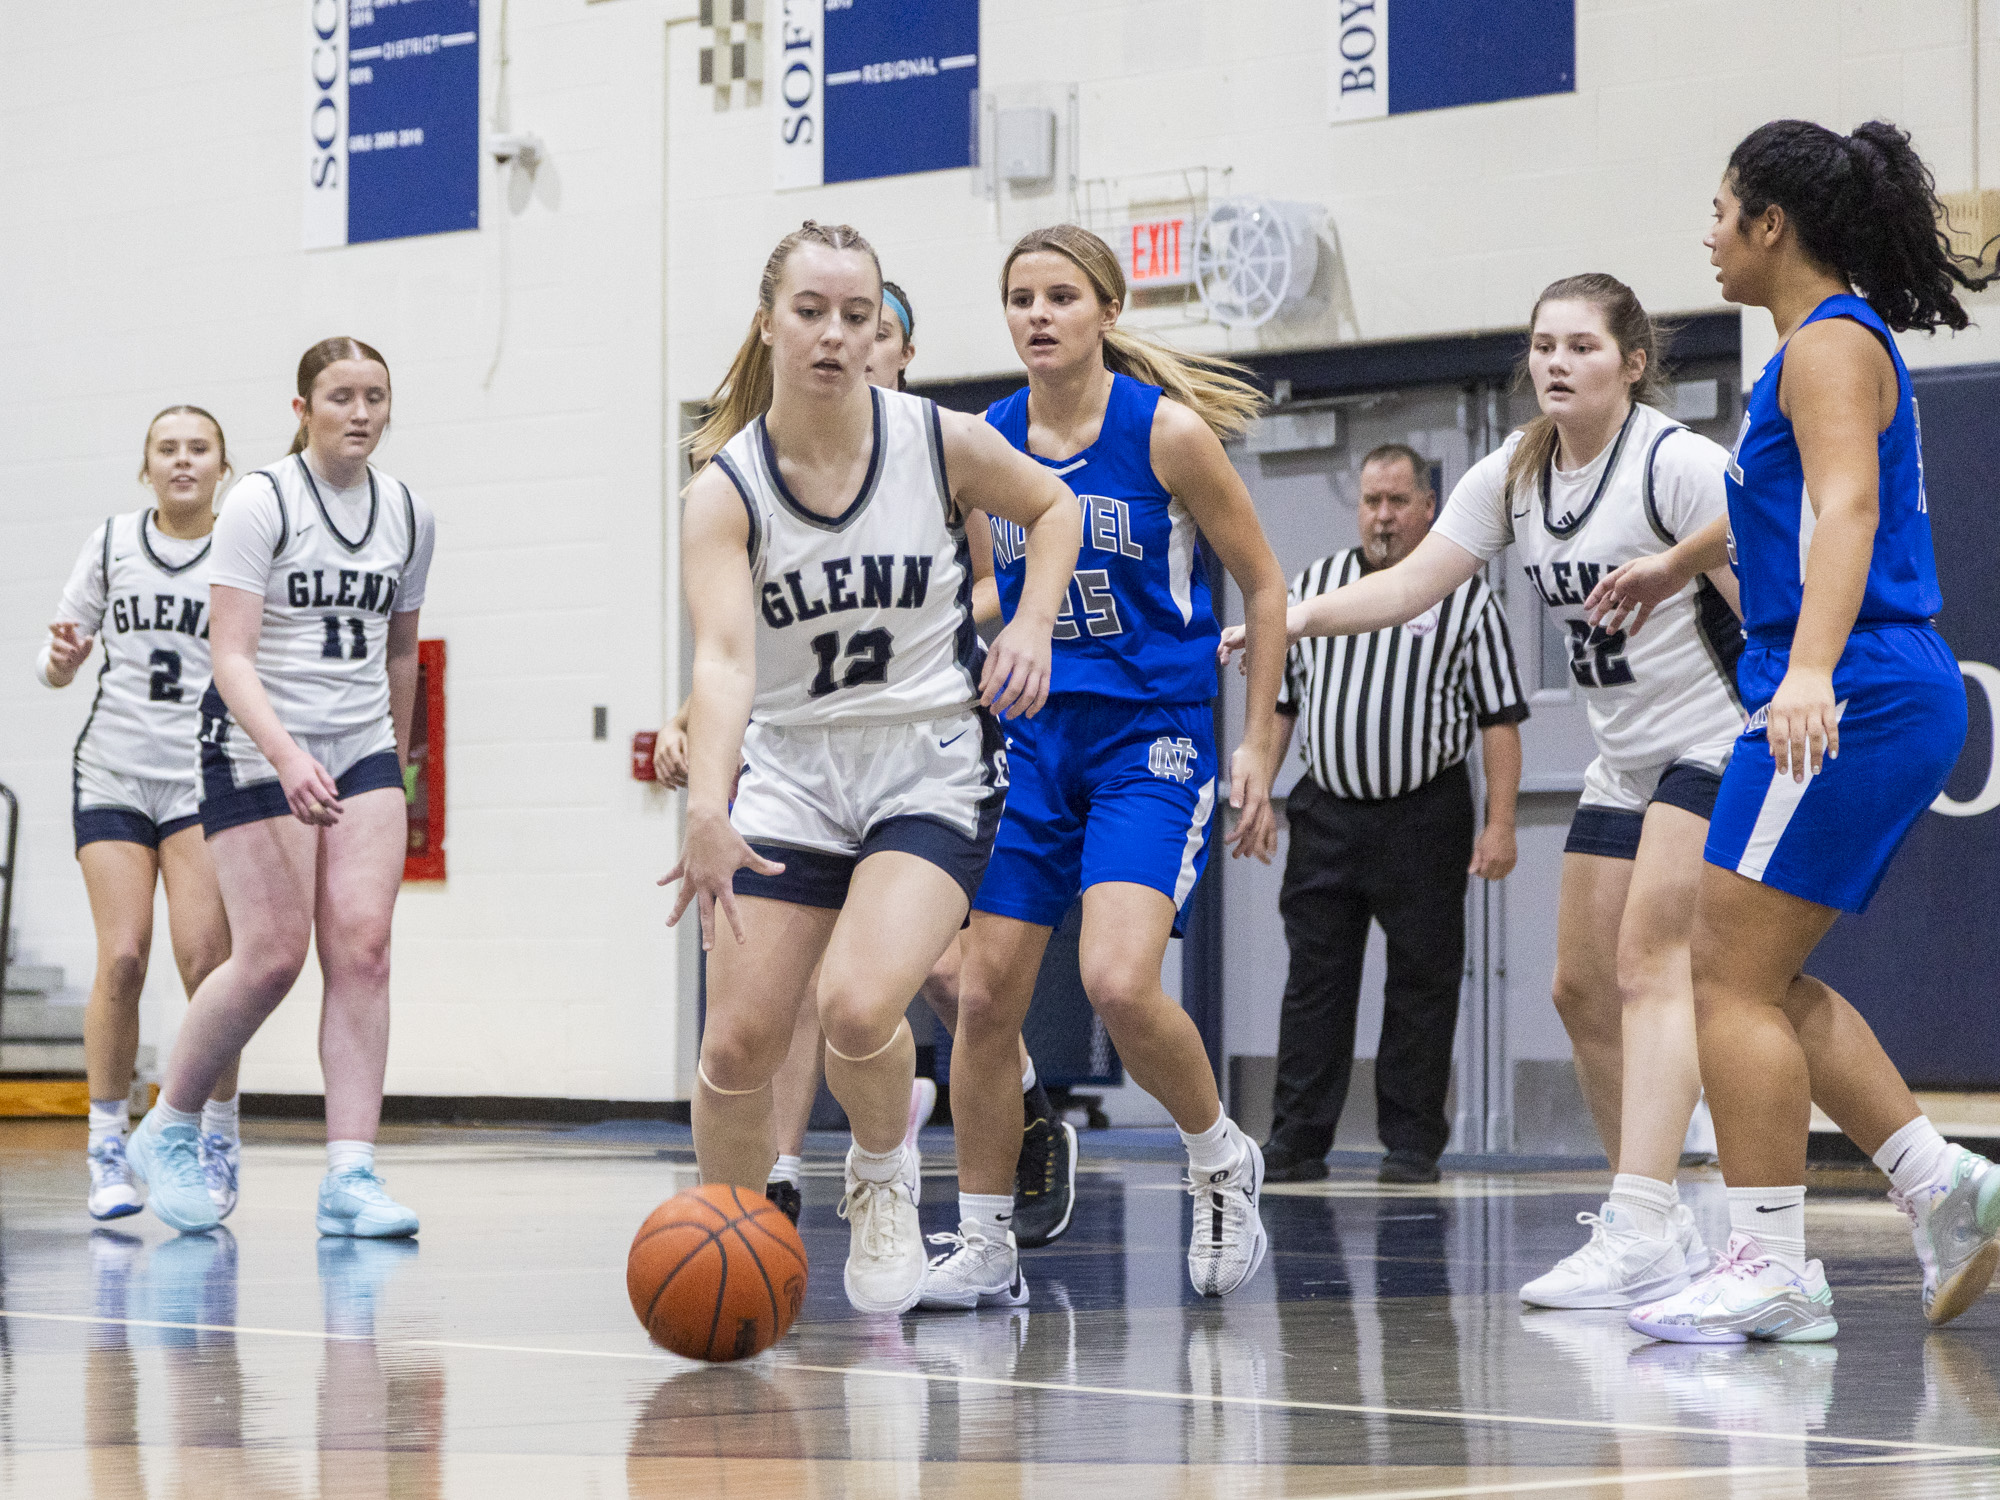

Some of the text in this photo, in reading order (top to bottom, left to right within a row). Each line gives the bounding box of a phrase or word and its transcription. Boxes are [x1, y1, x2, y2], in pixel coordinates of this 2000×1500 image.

[383, 33, 440, 61] DISTRICT
[782, 0, 814, 145] SOF
[862, 56, 938, 84] REGIONAL
[1132, 219, 1184, 279] EXIT
[761, 554, 933, 629] GLENN
[1523, 561, 1619, 609] LEN
[321, 615, 367, 660] 11
[807, 626, 895, 697] 12
[1564, 618, 1637, 688] 22
[149, 648, 184, 703] 2
